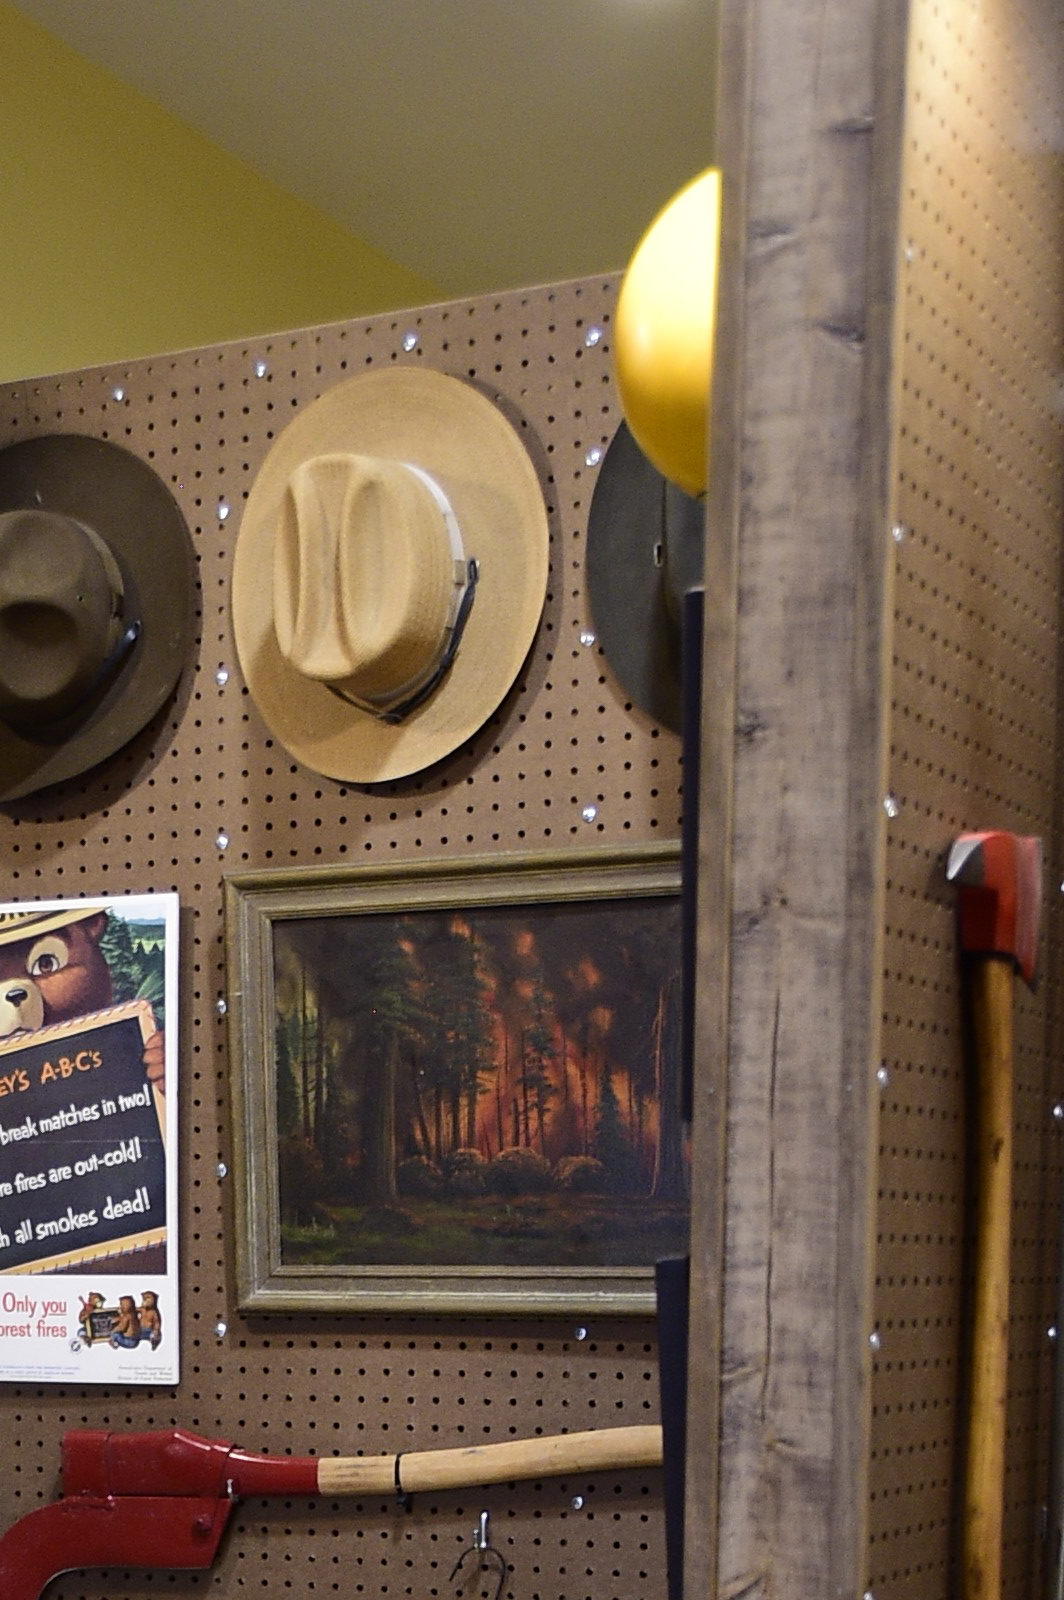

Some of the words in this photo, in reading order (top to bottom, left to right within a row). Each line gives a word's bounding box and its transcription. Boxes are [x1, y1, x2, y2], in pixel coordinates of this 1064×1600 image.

[39, 1103, 101, 1134] matches
[101, 1099, 117, 1117] in
[14, 1172, 47, 1193] fires
[48, 1166, 72, 1184] are
[74, 1136, 143, 1176] out-cold!
[15, 1218, 33, 1245] all
[35, 1206, 99, 1240] smokes
[102, 1186, 151, 1220] dead!
[2, 1292, 36, 1318] Only
[42, 1299, 67, 1317] you
[37, 1320, 67, 1337] fires
